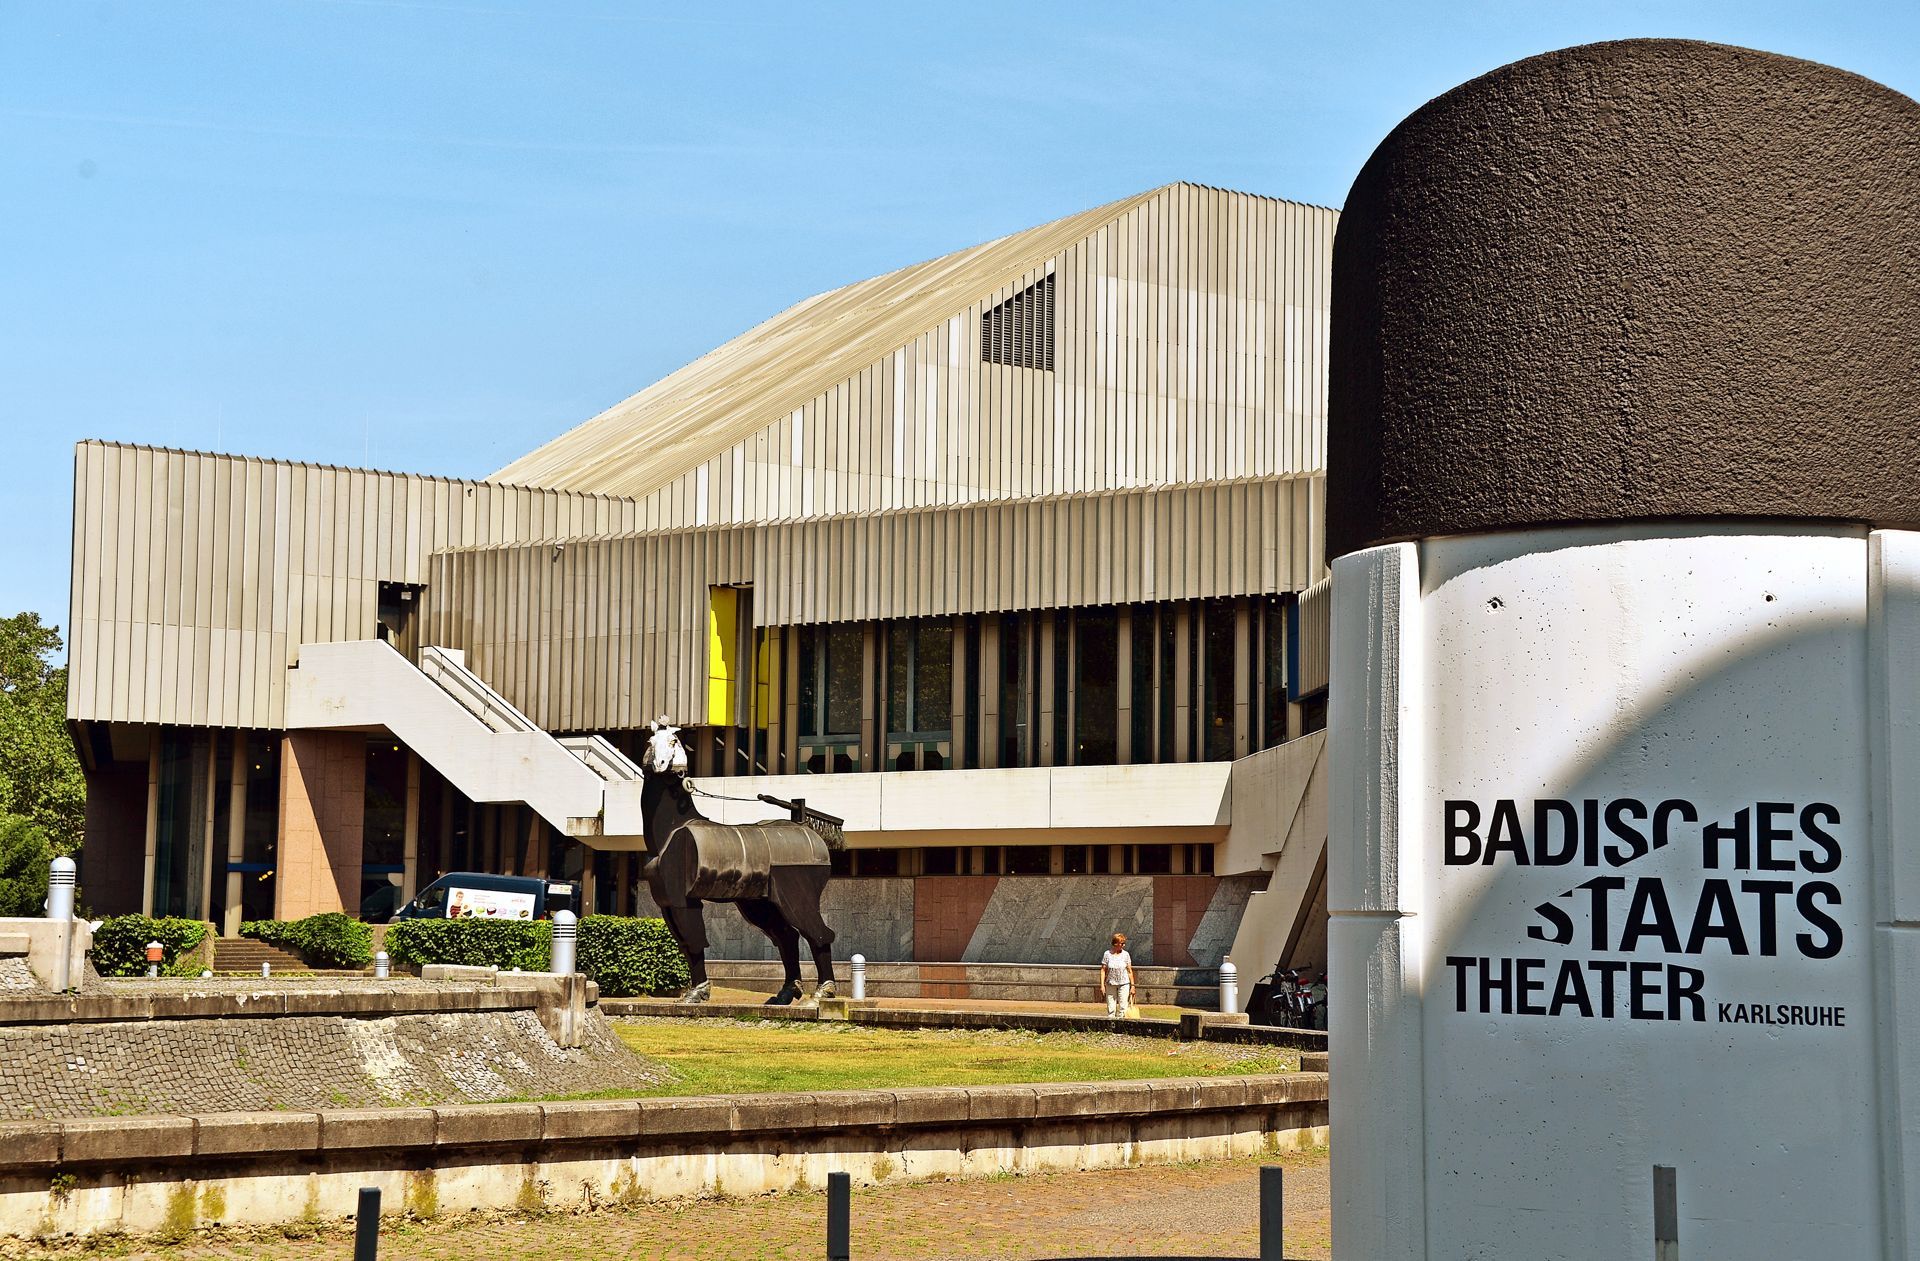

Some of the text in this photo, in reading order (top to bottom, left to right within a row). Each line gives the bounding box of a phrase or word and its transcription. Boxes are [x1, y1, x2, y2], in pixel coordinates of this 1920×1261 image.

[1443, 797, 1843, 875] BADISCHES
[1526, 874, 1845, 960] STAATS
[1445, 955, 1846, 1027] THEATER KARLSRUHE
